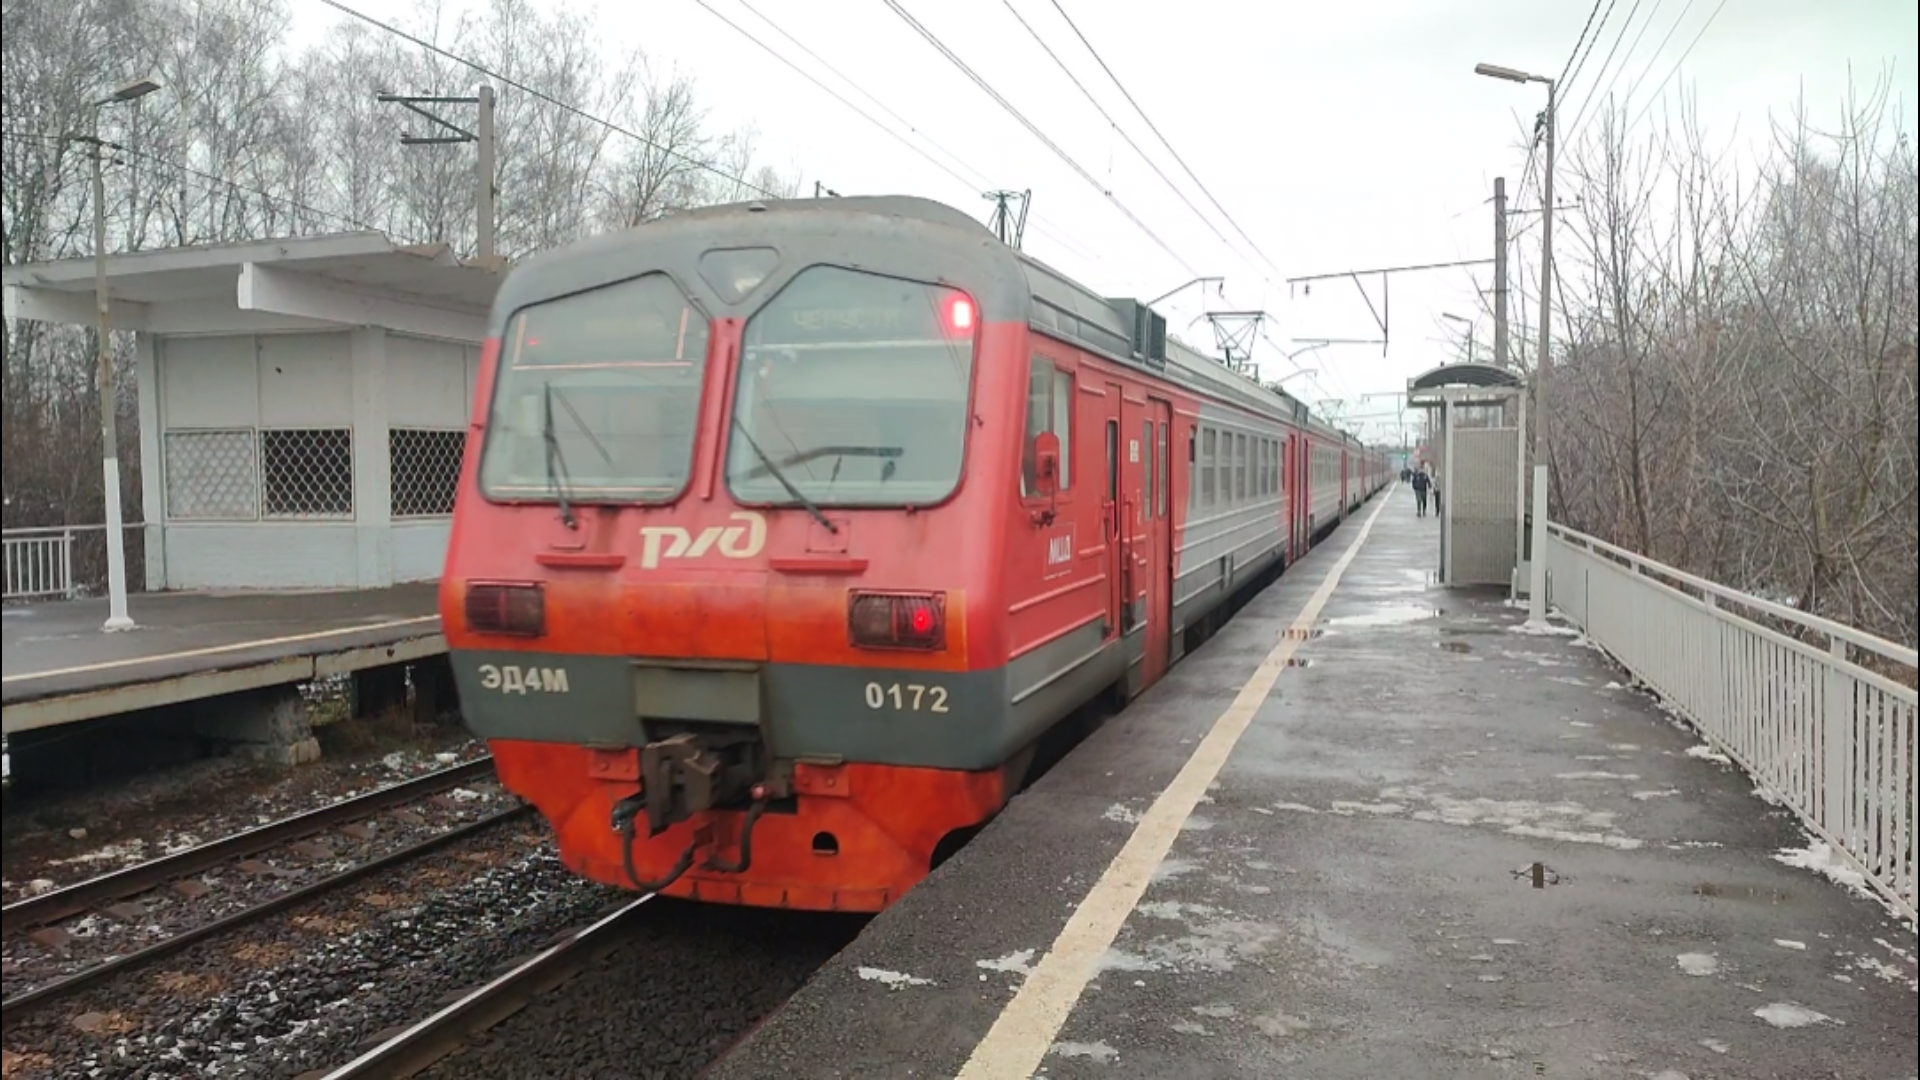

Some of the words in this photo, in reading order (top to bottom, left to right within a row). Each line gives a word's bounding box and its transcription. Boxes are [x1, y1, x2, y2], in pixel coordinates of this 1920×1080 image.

[639, 510, 768, 571] РЖД
[478, 664, 570, 695] ЭД4М
[865, 682, 950, 713] 0172
